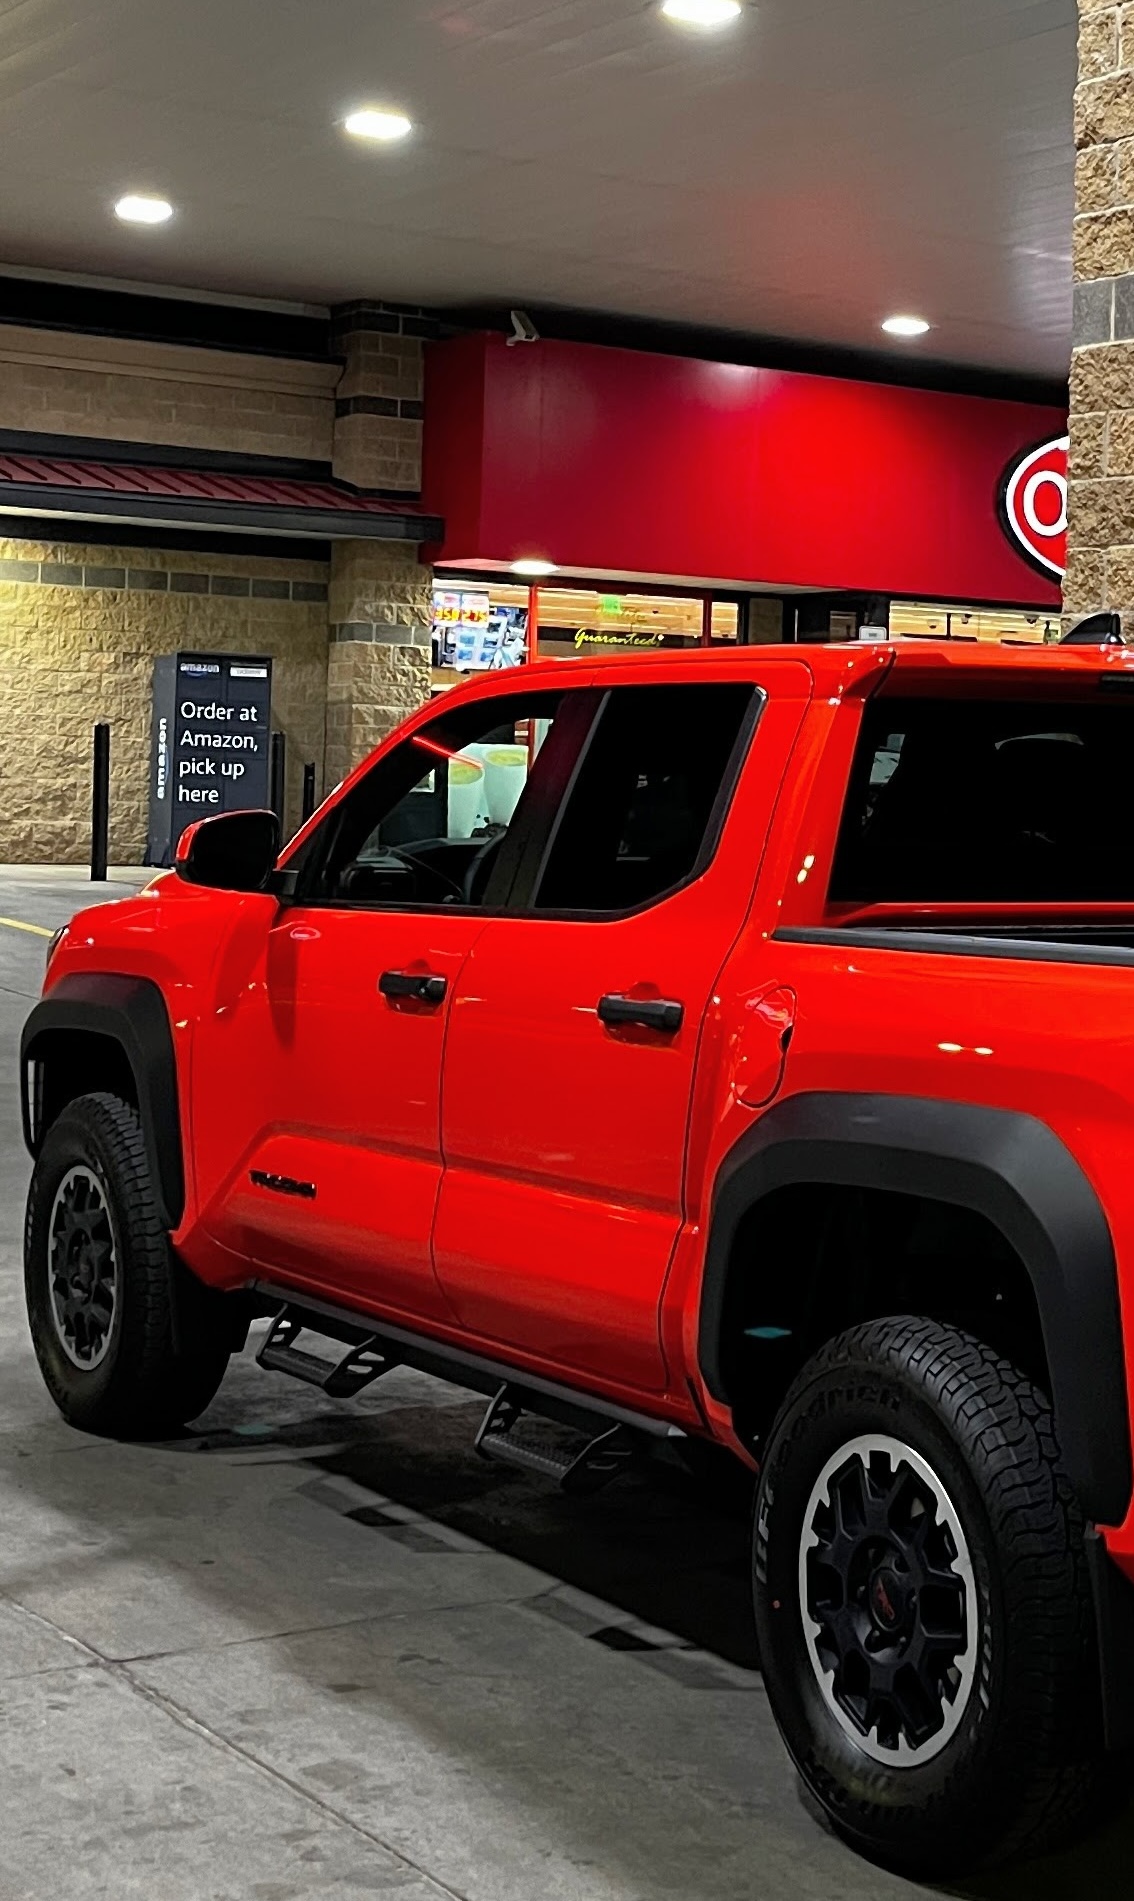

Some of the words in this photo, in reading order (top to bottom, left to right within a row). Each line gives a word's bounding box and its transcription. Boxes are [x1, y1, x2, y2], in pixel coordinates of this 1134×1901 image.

[180, 663, 220, 673] amazon
[180, 701, 235, 720] Order
[239, 706, 258, 722] at
[180, 730, 258, 752] Amazon,
[157, 718, 167, 799] amazon
[179, 758, 216, 778] pick
[221, 762, 245, 780] up
[178, 785, 219, 803] here
